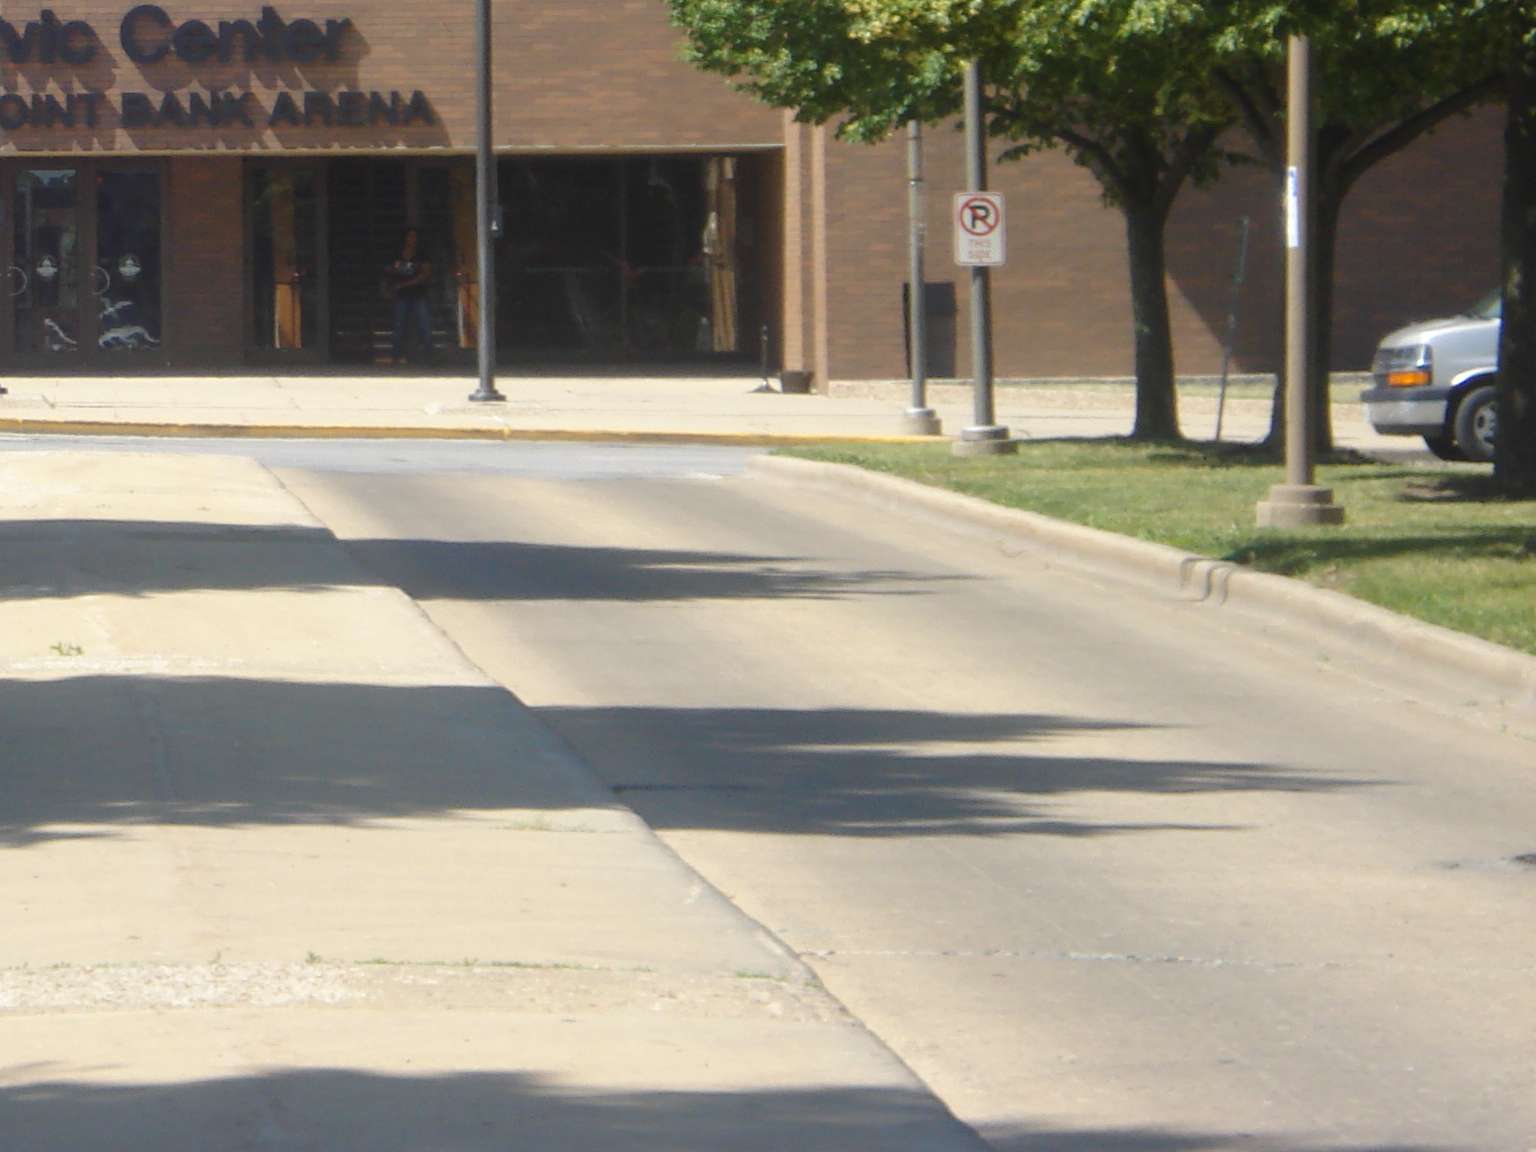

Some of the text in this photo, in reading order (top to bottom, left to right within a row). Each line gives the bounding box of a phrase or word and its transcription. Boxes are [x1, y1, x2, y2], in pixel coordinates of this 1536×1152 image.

[120, 4, 352, 64] Center
[121, 92, 255, 128] BANK
[268, 90, 436, 127] ARENA
